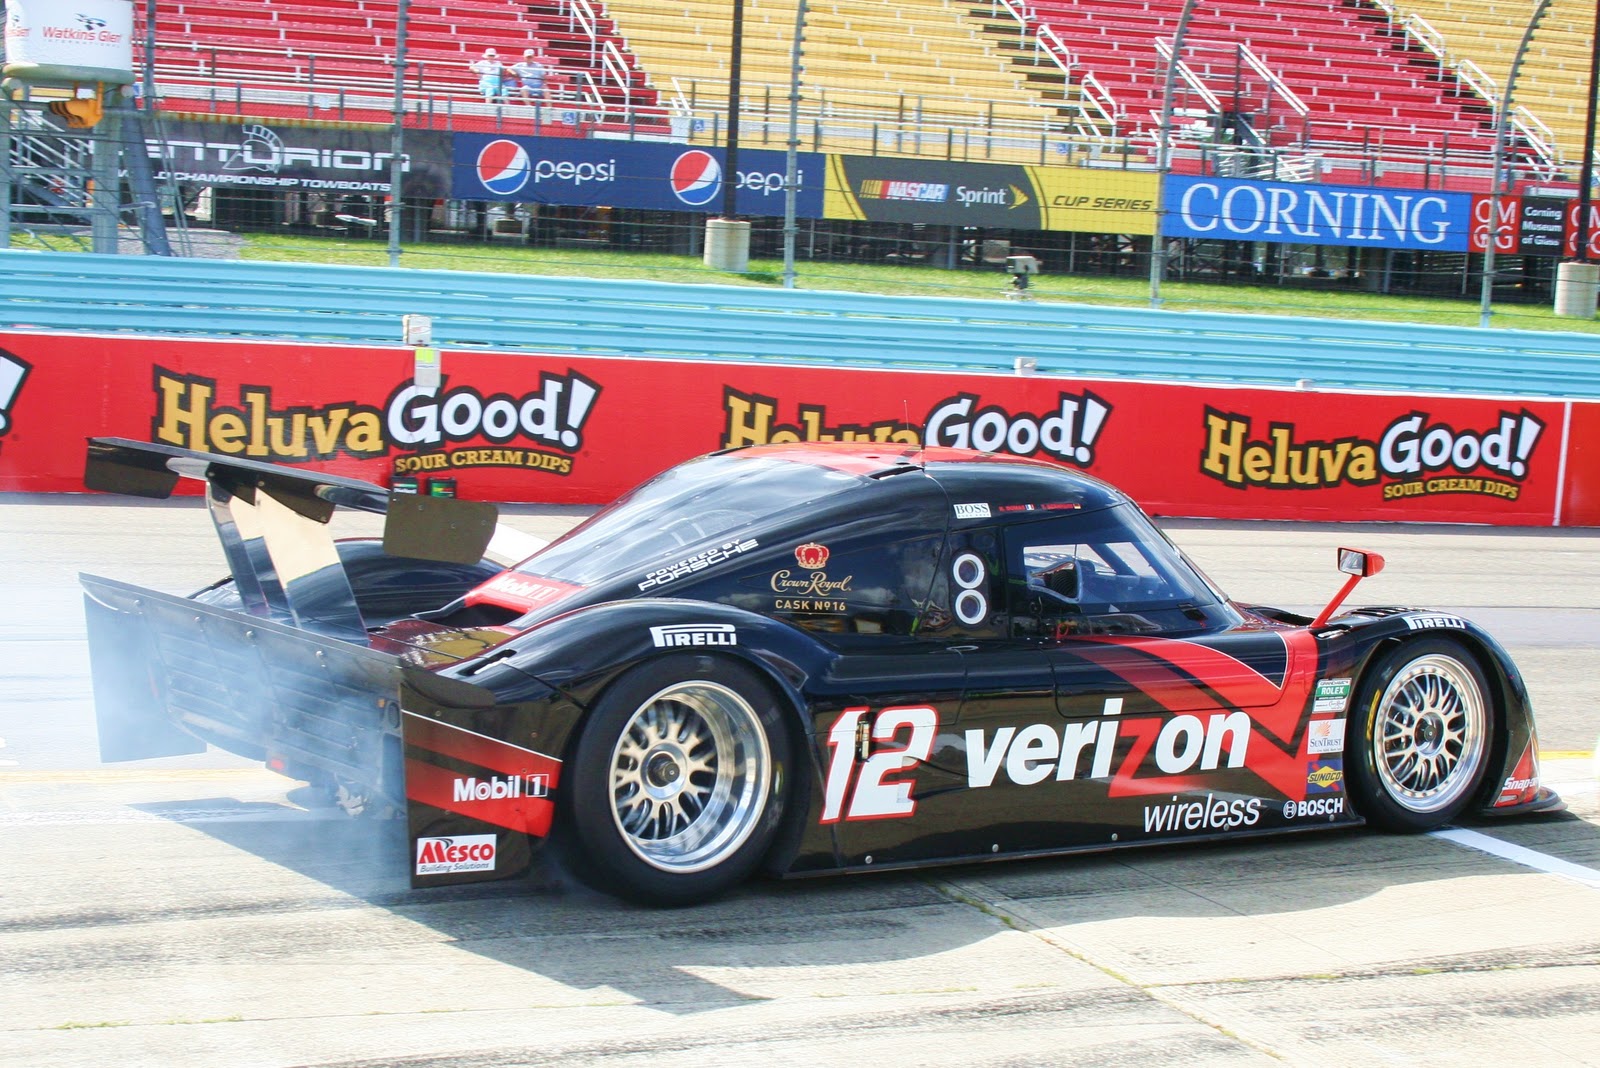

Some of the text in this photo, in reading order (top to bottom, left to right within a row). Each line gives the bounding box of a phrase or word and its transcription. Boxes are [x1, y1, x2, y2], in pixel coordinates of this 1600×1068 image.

[43, 26, 96, 41] Watkins
[173, 171, 299, 186] CHAMPIONSHIP
[301, 179, 392, 191] TOWBOATS
[534, 158, 616, 186] pepsi
[886, 181, 1007, 207] NASCAR Sprint
[1053, 194, 1152, 211] CUP SERIES
[1180, 182, 1451, 244] CORNING
[1524, 207, 1562, 220] Corning
[1522, 221, 1562, 232] Museum
[1522, 235, 1532, 244] of
[157, 374, 384, 457] Heluva
[387, 378, 597, 448] Good!
[925, 397, 1108, 463] Good!
[1204, 414, 1377, 484] Heluva
[1380, 416, 1542, 477] Good!
[395, 450, 572, 474] SOUR CREAM DIPS
[1384, 478, 1519, 499] SOUR CREAM DIPS
[956, 503, 990, 514] BOSS
[637, 538, 760, 592] PORSCHE
[645, 539, 741, 580] POWERED BY
[770, 569, 852, 597] Crown Royal
[775, 599, 810, 610] CASK
[1401, 615, 1466, 630] PIRELLI
[650, 624, 737, 648] PIRELLI
[1321, 686, 1344, 695] ROLEX
[964, 698, 1252, 798] verizon
[819, 705, 940, 824] 12
[453, 775, 521, 803] Mobil
[1308, 772, 1341, 783] SUNOCO
[1142, 793, 1262, 833] wireless
[1297, 797, 1344, 817] BOSCH
[420, 862, 490, 873] Building Solutions
